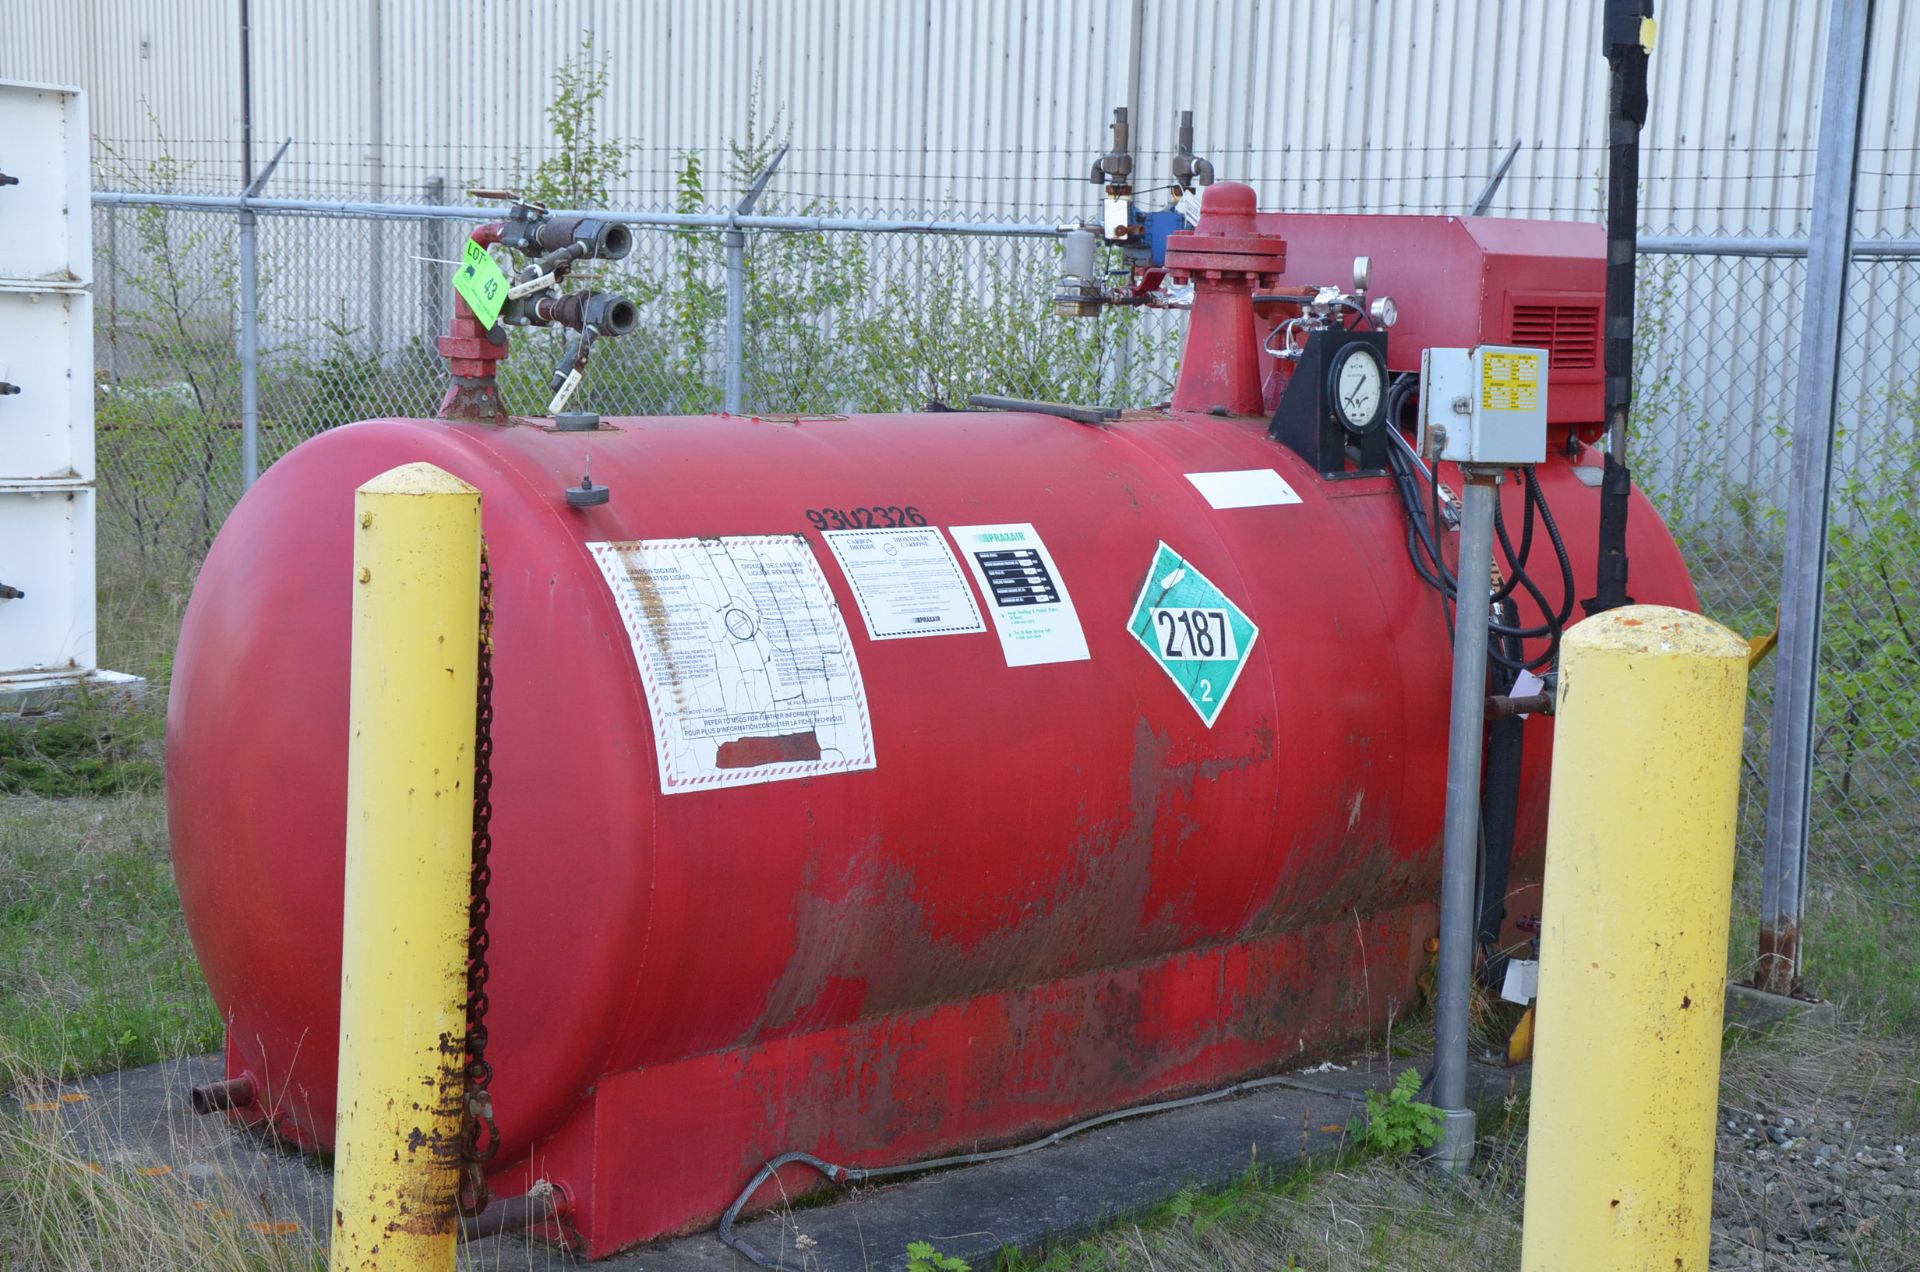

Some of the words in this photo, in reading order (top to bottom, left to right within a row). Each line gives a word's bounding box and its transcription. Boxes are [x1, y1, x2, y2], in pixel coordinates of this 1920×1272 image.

[484, 278, 498, 300] 43
[806, 506, 928, 531] 93U2326
[988, 532, 1026, 543] PRAXAIR
[626, 568, 653, 576] CARBON
[917, 616, 941, 624] PRAXAIR
[1158, 610, 1226, 658] 2187
[1200, 678, 1213, 702] 2
[684, 729, 701, 737] POUR
[701, 728, 716, 736] PLUS
[717, 723, 758, 735] D'INFORMATION
[759, 720, 790, 730] CONSULTER
[791, 719, 798, 727] LA
[798, 717, 813, 725] FICHE
[814, 714, 843, 724] TECHNIQUE
[704, 718, 722, 727] REFER
[723, 717, 731, 725] TO
[731, 716, 747, 724] MSDS
[748, 714, 759, 722] FOR
[760, 712, 784, 721] FURTHER
[784, 710, 820, 719] INFORMATION
